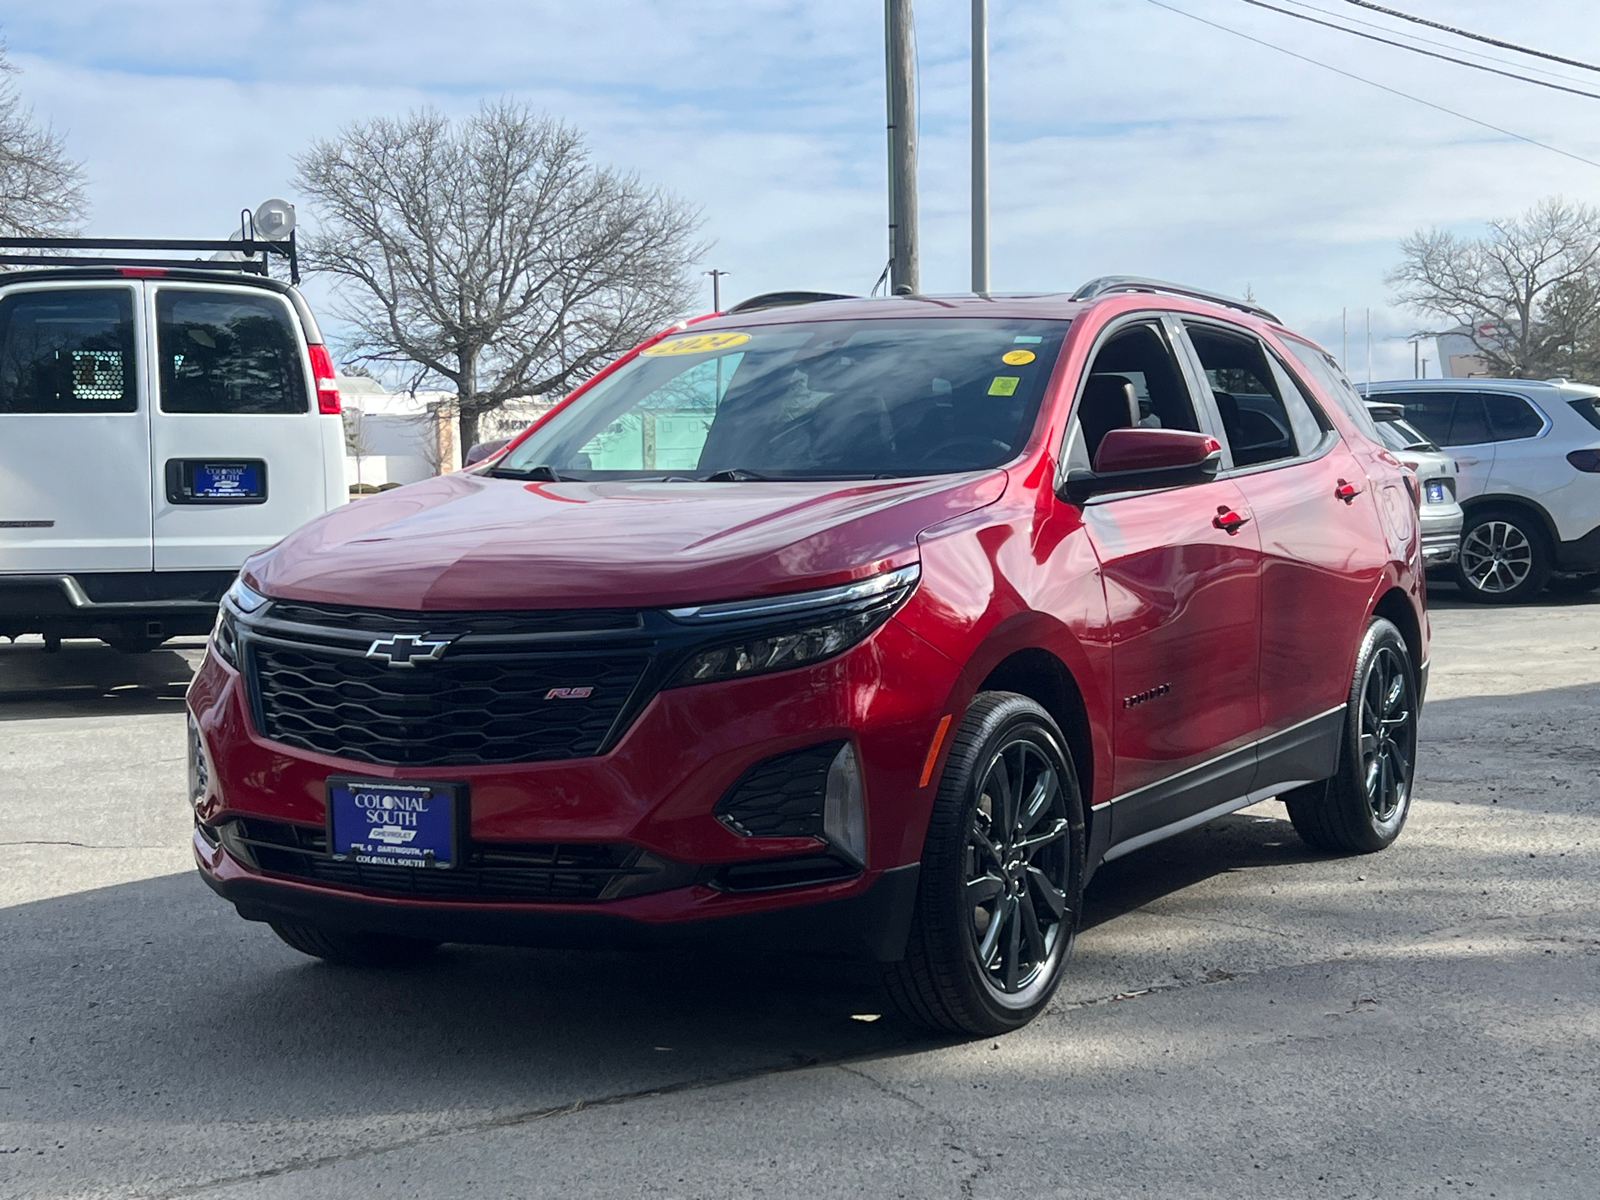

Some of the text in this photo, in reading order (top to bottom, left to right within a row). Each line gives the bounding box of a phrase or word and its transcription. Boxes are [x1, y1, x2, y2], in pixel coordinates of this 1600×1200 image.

[544, 686, 594, 699] RS
[354, 794, 429, 812] COLONIAL
[366, 809, 417, 826] SOUTH
[372, 829, 413, 840] CHEVROLET
[367, 844, 373, 852] 6
[356, 855, 426, 868] COLONIAL SOUTH
